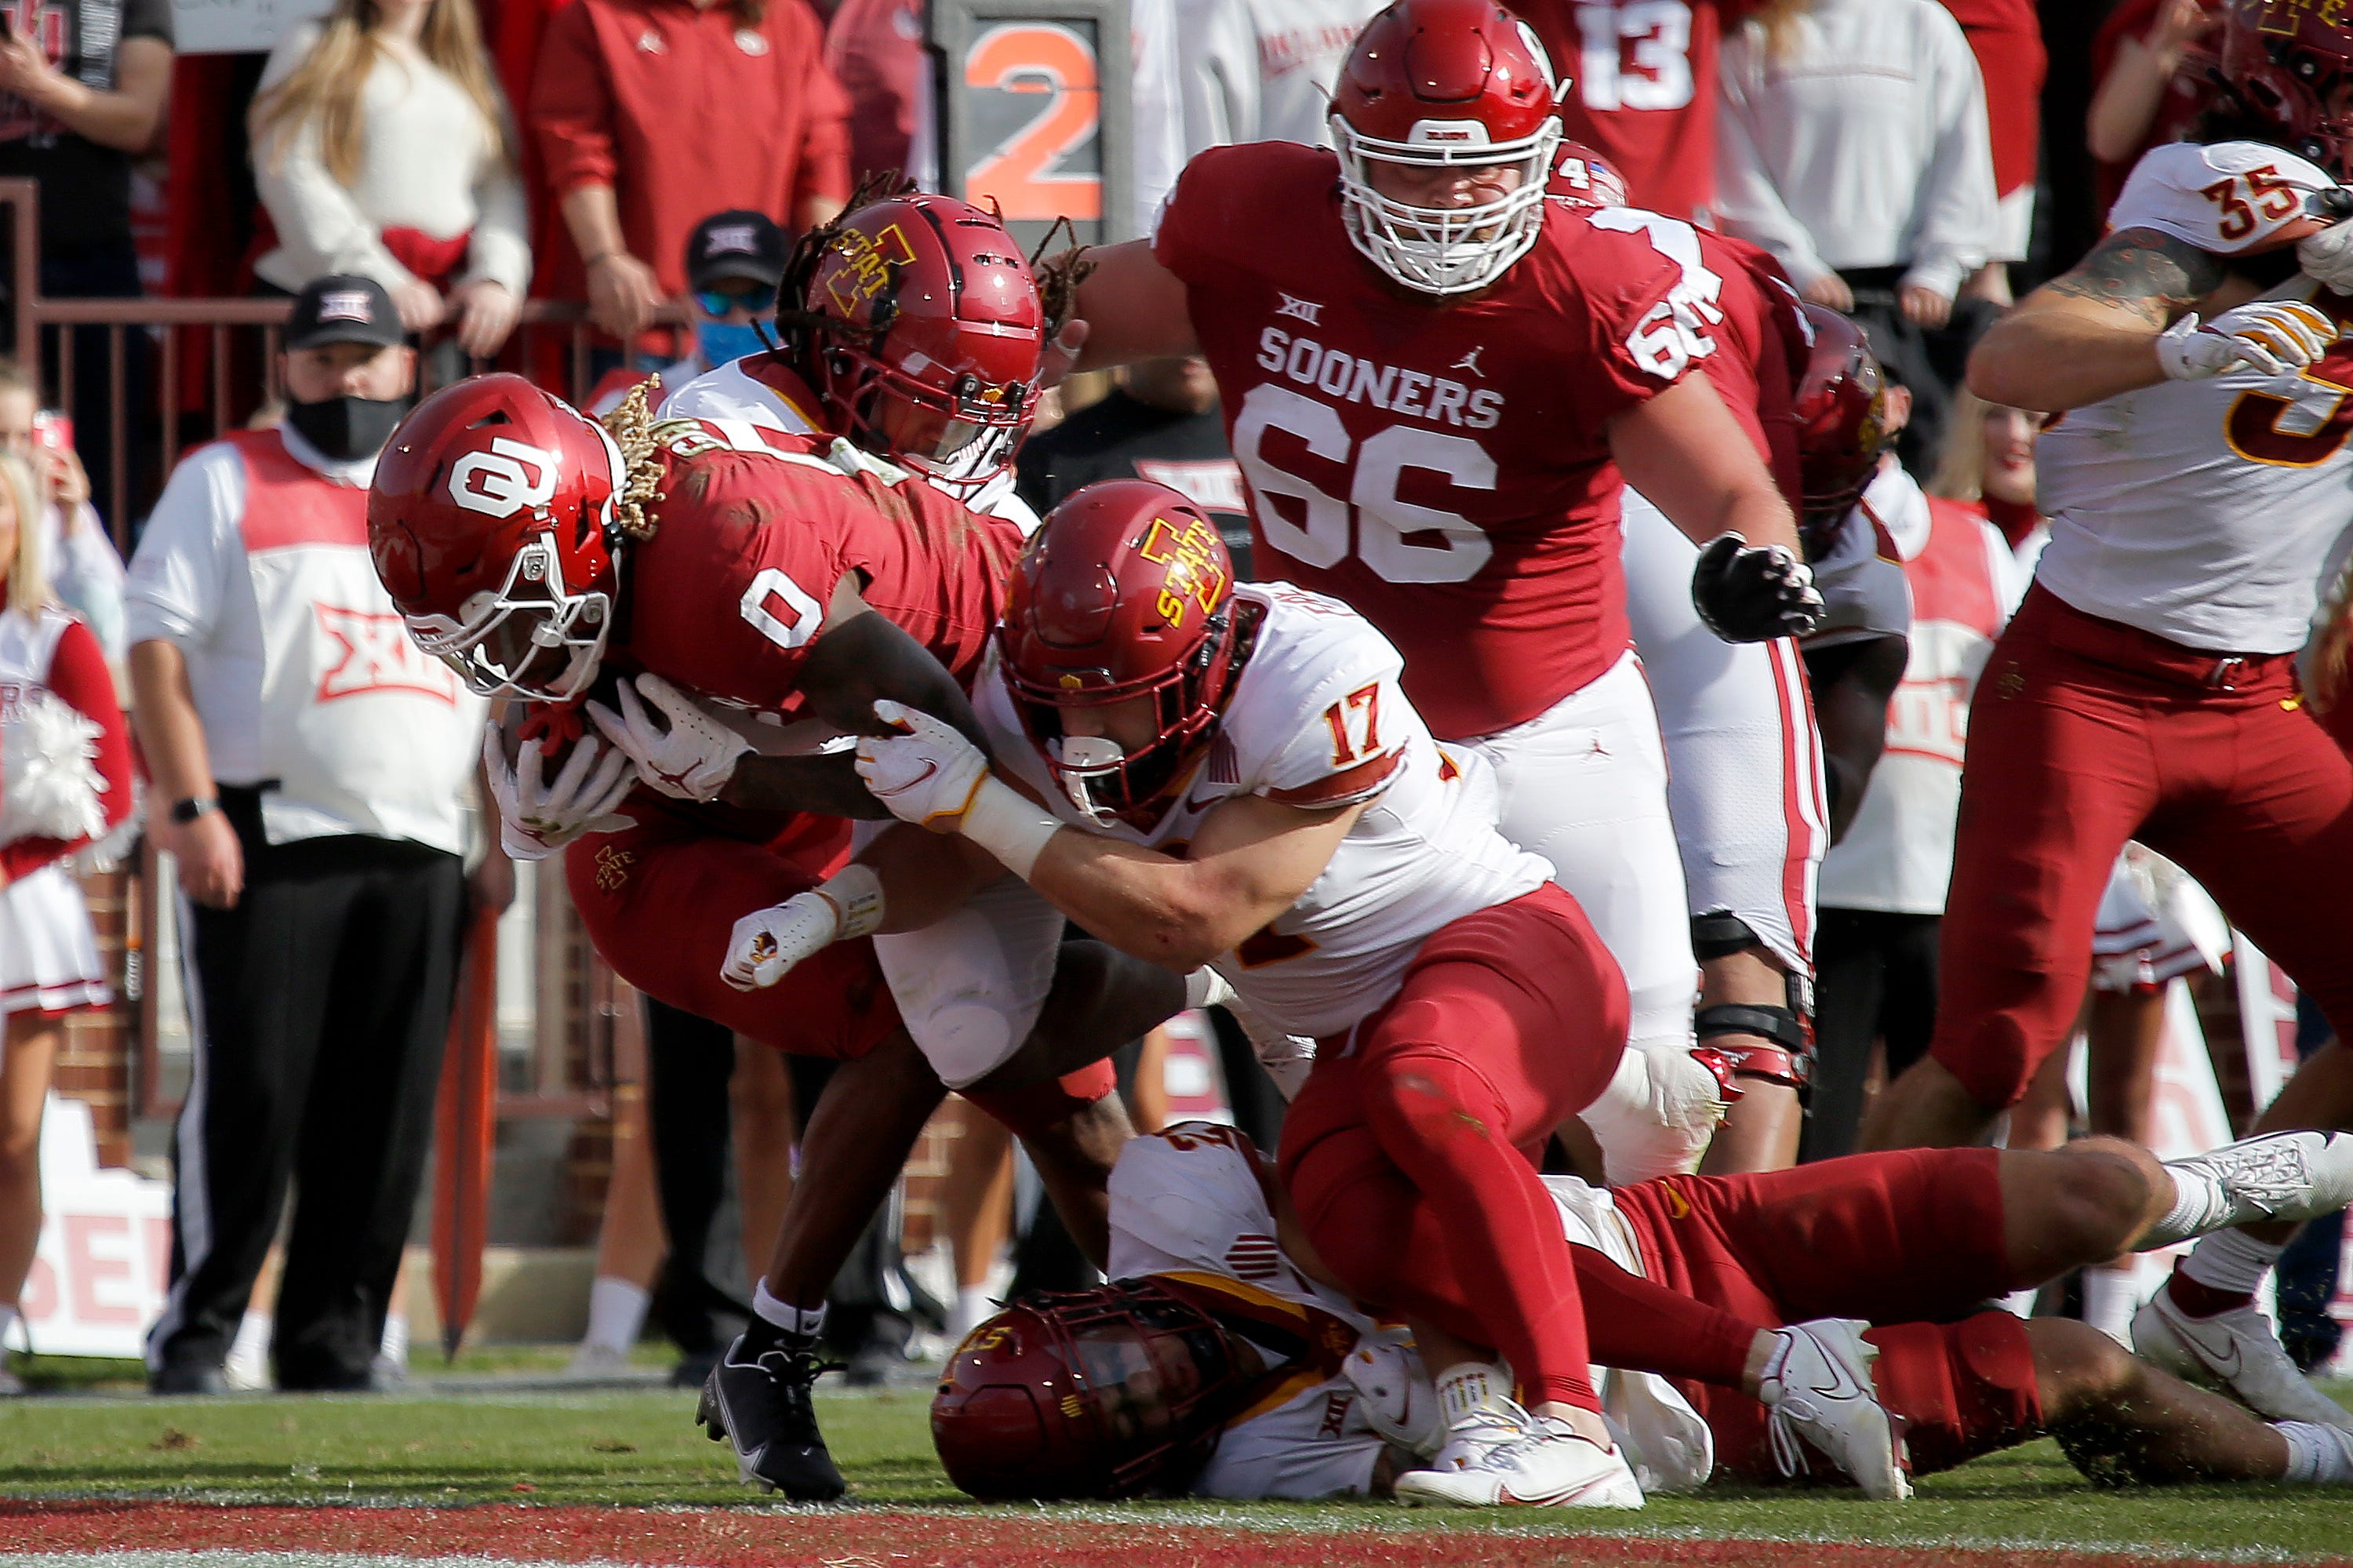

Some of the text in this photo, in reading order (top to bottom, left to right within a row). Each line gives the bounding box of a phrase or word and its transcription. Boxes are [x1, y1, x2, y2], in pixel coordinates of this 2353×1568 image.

[1576, 1, 1693, 111] 13
[965, 21, 1104, 220] 2
[2201, 163, 2300, 242] 35
[1257, 326, 1506, 430] SOONERS
[449, 437, 558, 518] OU
[1232, 382, 1498, 584] 66
[740, 567, 824, 649] 0
[1324, 681, 1382, 769] 17
